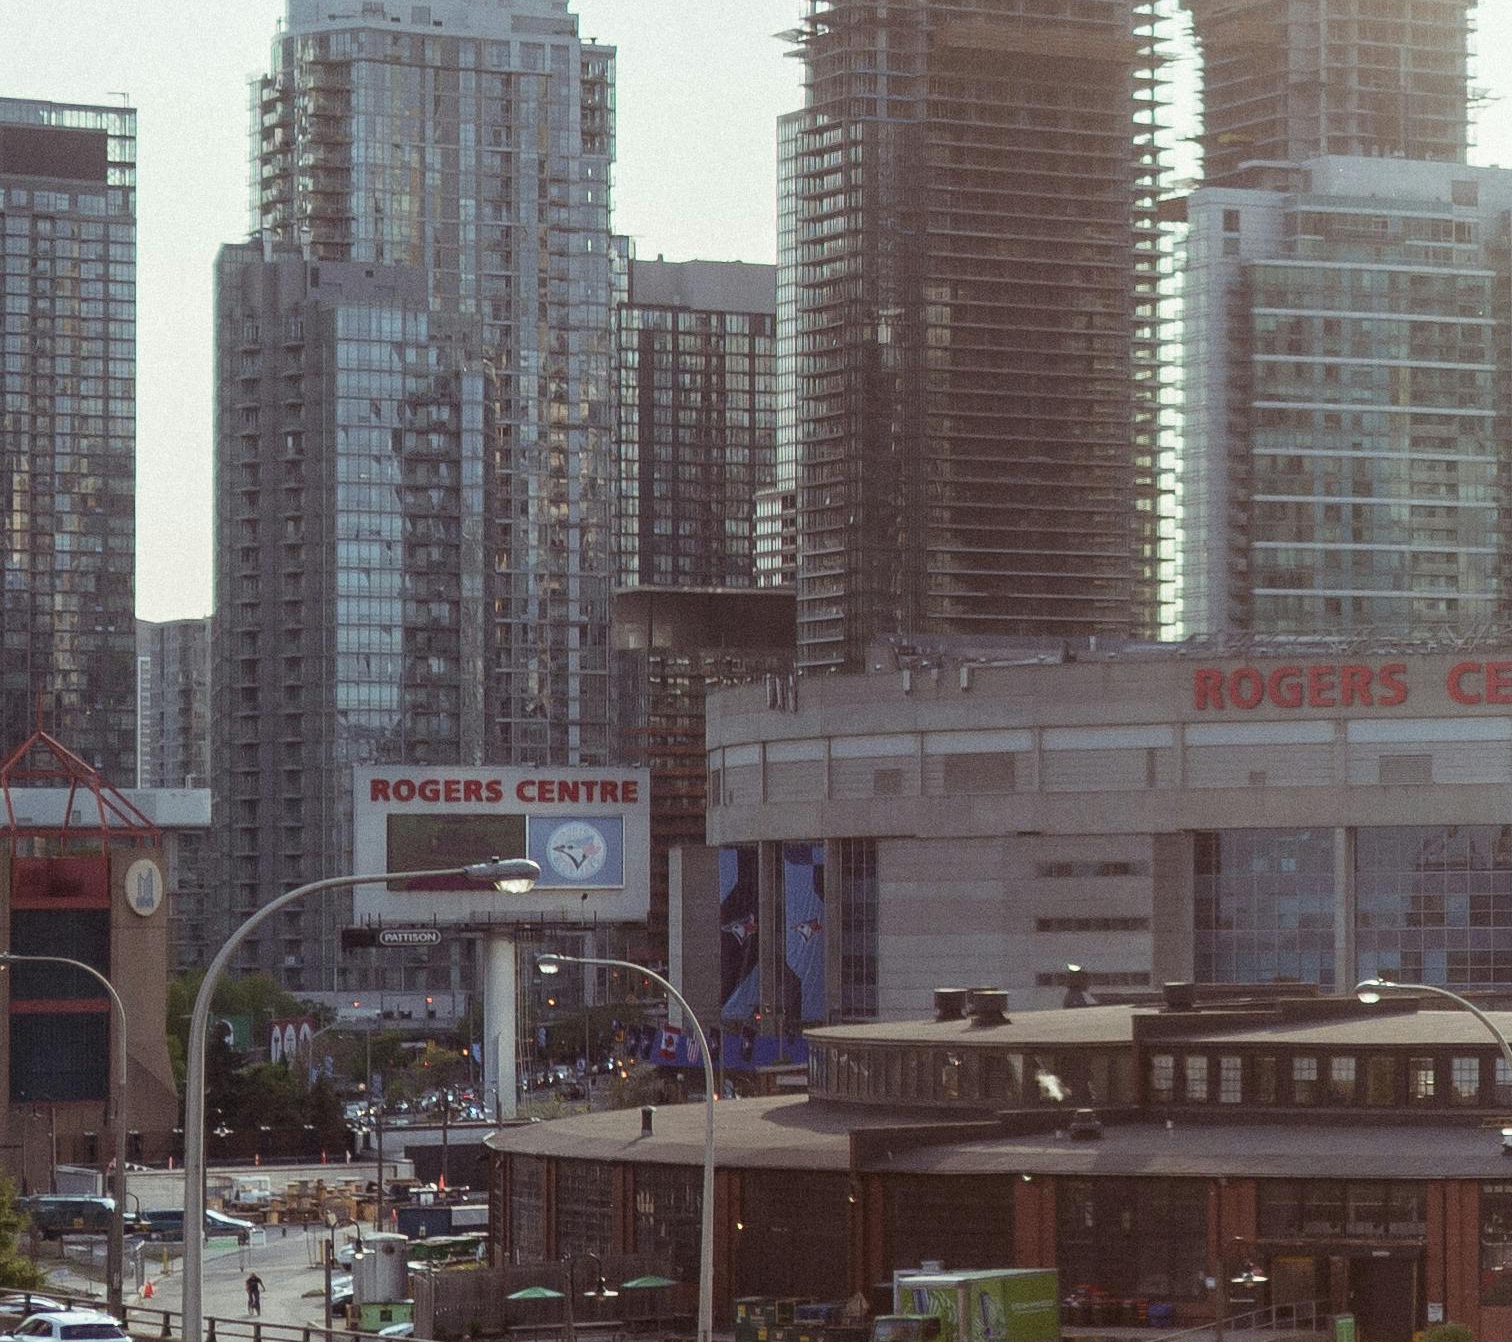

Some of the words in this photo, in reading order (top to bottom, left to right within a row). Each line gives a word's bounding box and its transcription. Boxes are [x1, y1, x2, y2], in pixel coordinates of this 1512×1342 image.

[1193, 663, 1408, 711] ROGERS
[369, 778, 504, 804] ROGERS
[515, 779, 640, 804] CENTRE
[384, 932, 437, 943] PATTISON
